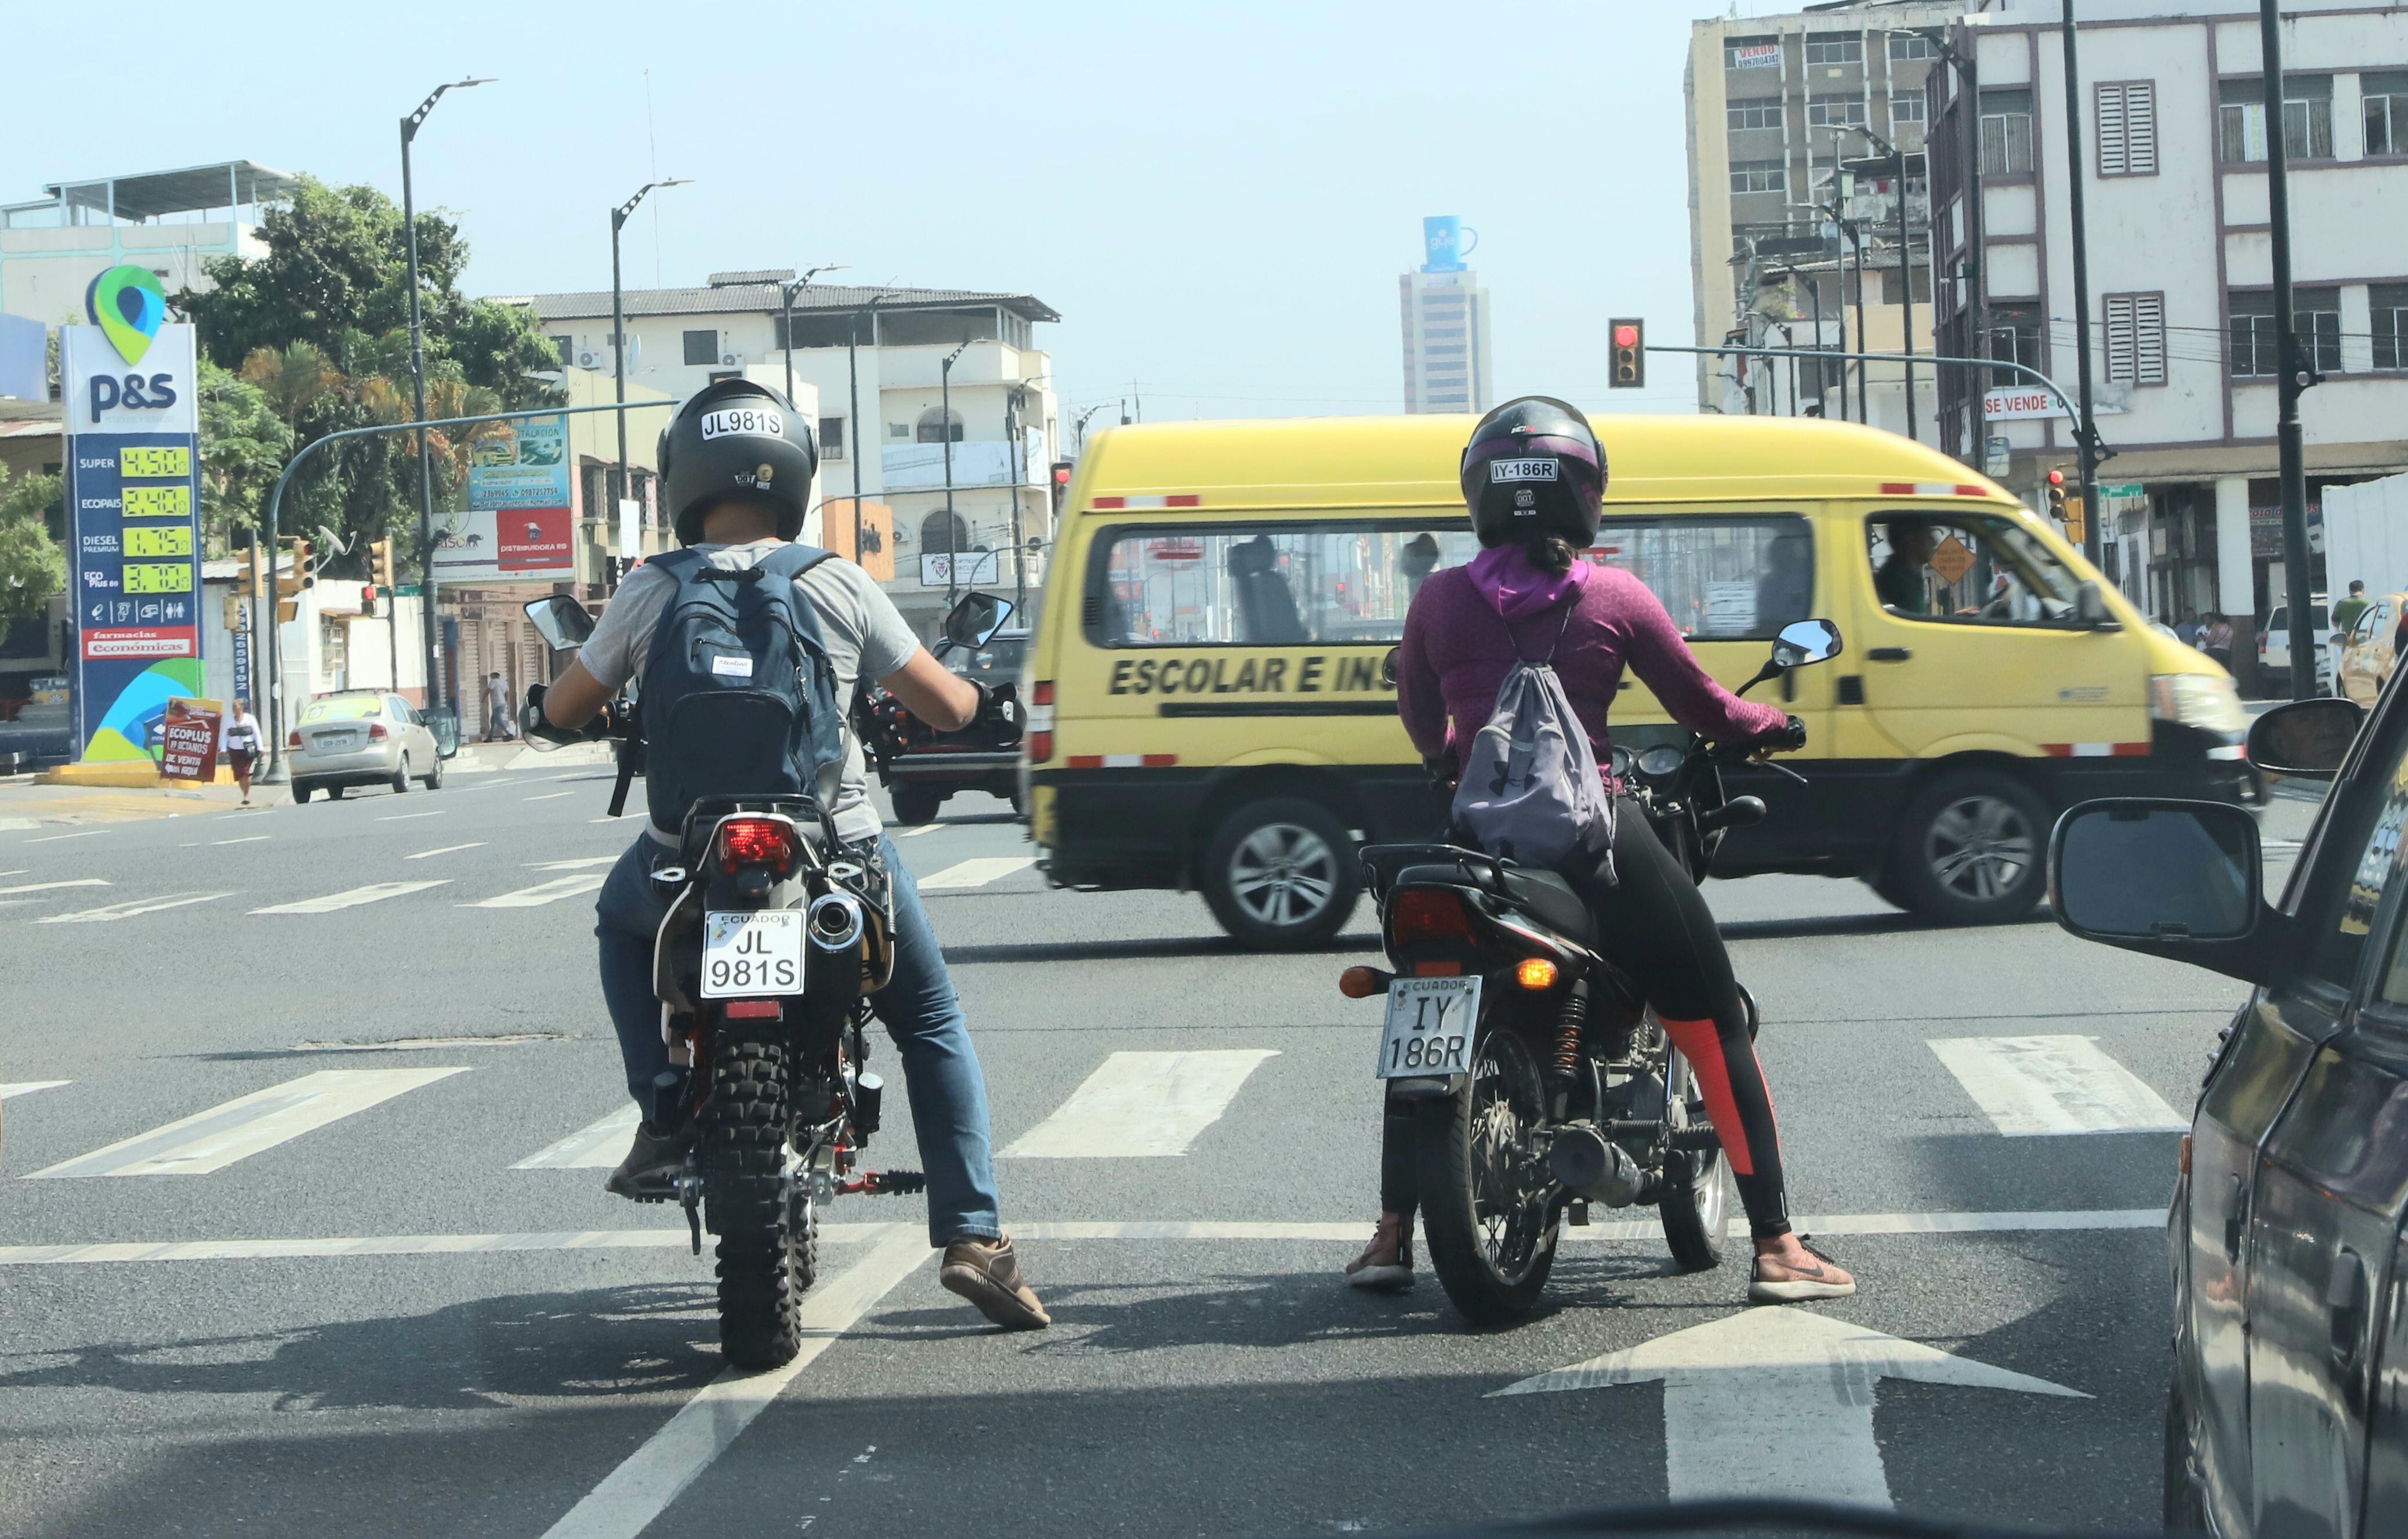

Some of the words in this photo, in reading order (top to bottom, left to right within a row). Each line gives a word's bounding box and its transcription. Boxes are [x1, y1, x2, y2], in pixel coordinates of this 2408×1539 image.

[1741, 45, 1774, 57] VENDO
[1431, 237, 1455, 251] gye
[1986, 398, 2001, 413] SE
[2006, 395, 2047, 411] VENDE
[705, 411, 780, 435] JL981S
[80, 459, 115, 468] SUPER
[1495, 463, 1553, 477] IY-186R
[82, 499, 122, 508] ECOPAIS
[83, 535, 118, 545] DIESEL
[501, 544, 555, 553] DISTRIBUIDORA
[84, 571, 103, 580] ECO
[89, 580, 107, 588] Plus
[93, 631, 157, 639] farmacias
[93, 642, 183, 653] económicas
[1109, 658, 1289, 695] ESCOLAR
[1297, 656, 1328, 693] E
[169, 727, 212, 744] ECOPLUS
[178, 741, 208, 755] OCTANOS
[165, 754, 176, 763] DE
[177, 755, 202, 766] VENTA
[721, 915, 790, 924] ECUADOR
[737, 930, 773, 955] JL
[712, 959, 795, 987] 981S
[1404, 980, 1467, 991] ECUADOR
[1413, 997, 1452, 1030] IY
[1391, 1035, 1465, 1069] 186R
